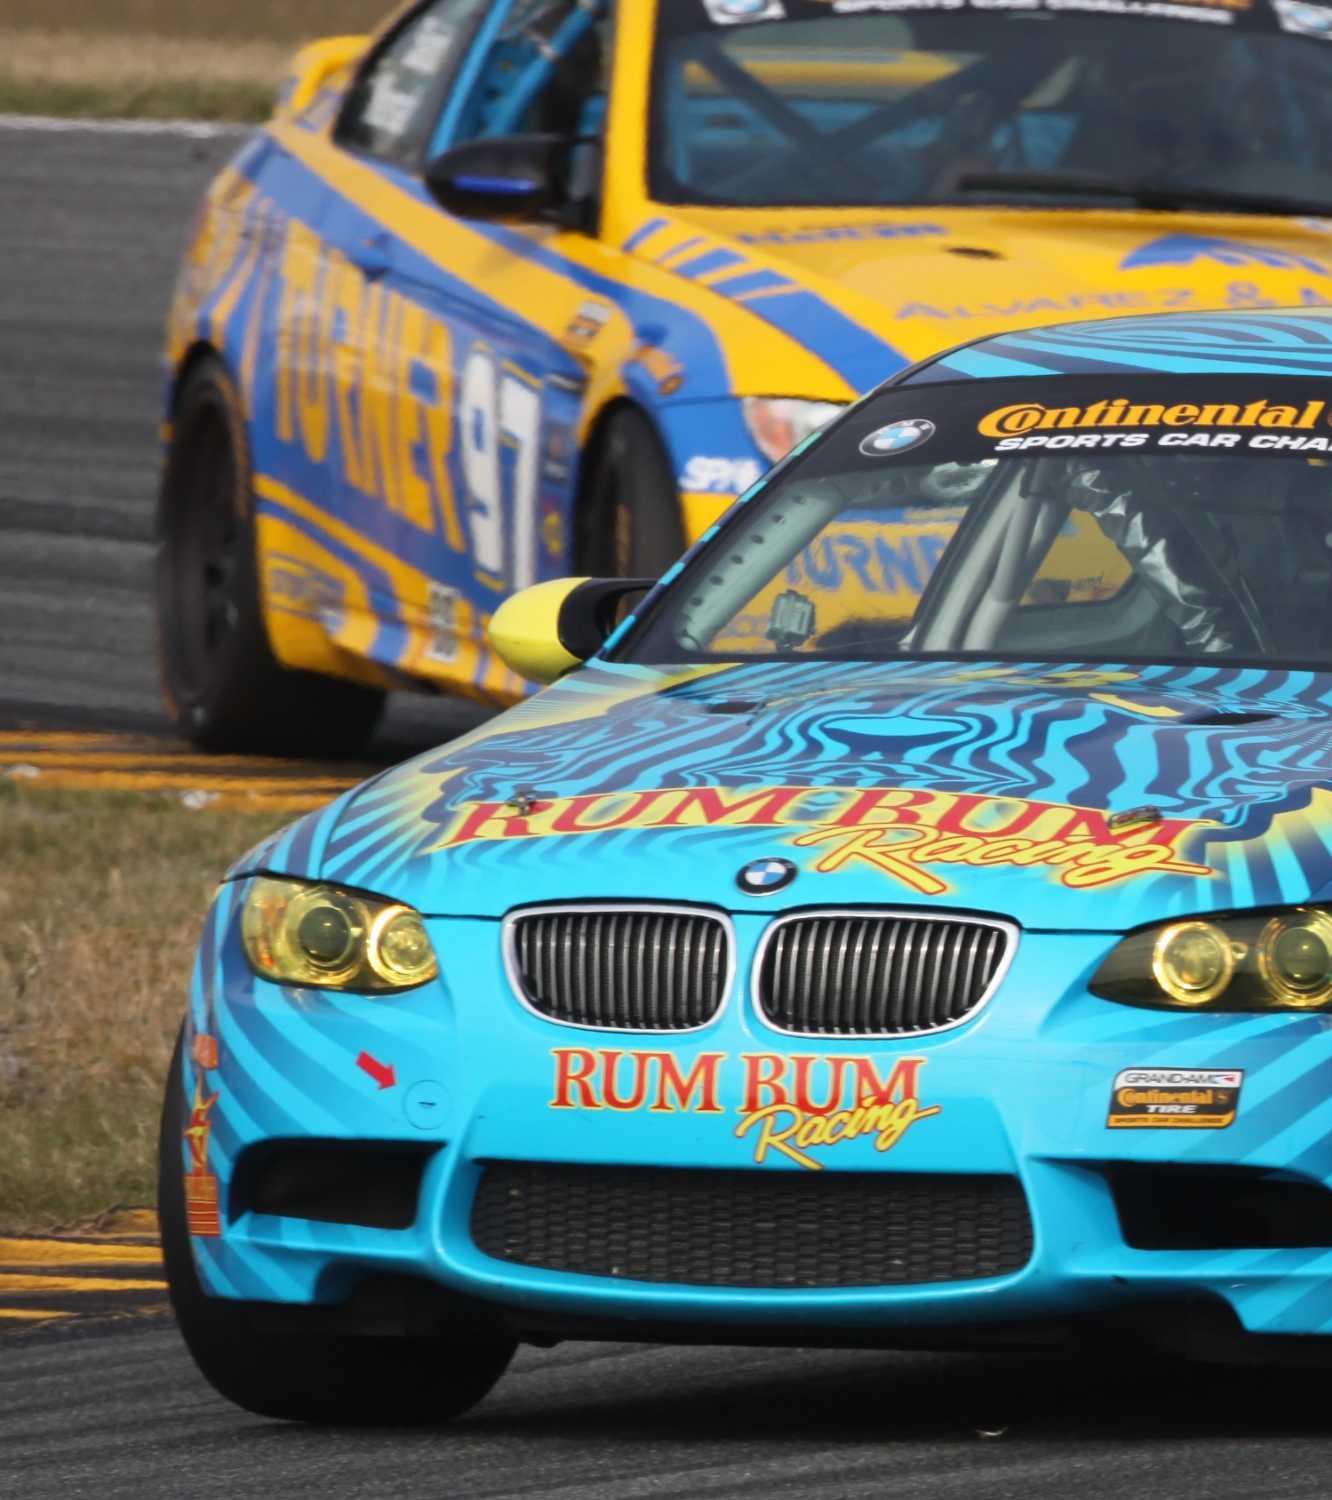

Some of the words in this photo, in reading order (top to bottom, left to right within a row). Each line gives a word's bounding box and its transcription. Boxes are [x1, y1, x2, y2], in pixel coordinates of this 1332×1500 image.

[976, 398, 1326, 438] Continental
[994, 433, 1150, 452] SPORTS
[1157, 432, 1242, 448] CAR
[457, 340, 544, 592] 97
[437, 785, 814, 849] RUM
[826, 786, 1212, 848] BUM
[793, 822, 1214, 896] Racing
[550, 1048, 727, 1113] RUM
[738, 1051, 928, 1116] BUM
[1145, 1103, 1199, 1114] TIRE
[734, 1095, 941, 1171] Racing
